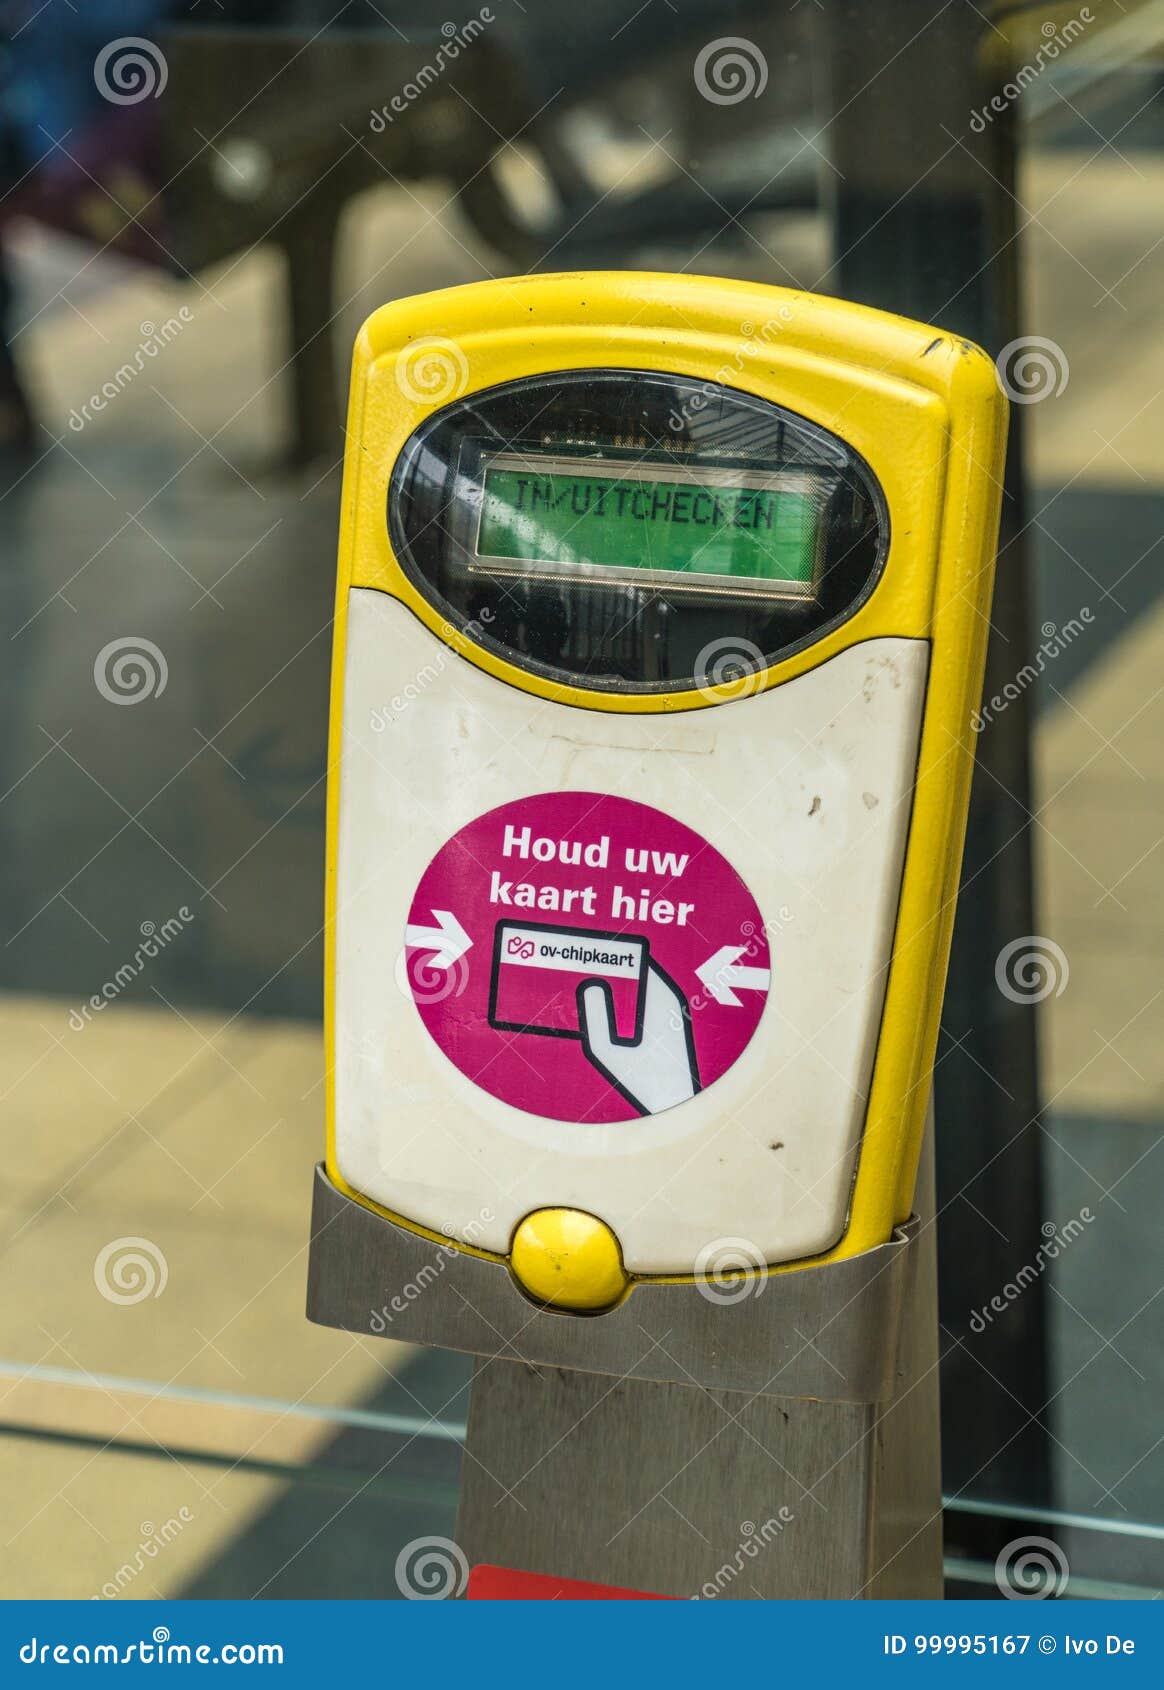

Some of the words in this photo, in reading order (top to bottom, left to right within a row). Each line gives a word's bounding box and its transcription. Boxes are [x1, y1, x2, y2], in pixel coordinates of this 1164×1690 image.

[513, 479, 775, 530] IN/UITCHECKEN
[502, 824, 610, 868] Houd
[624, 848, 689, 877] uw
[489, 871, 597, 916] kaart
[611, 885, 695, 926] hier
[539, 943, 635, 968] ov-chipkaart
